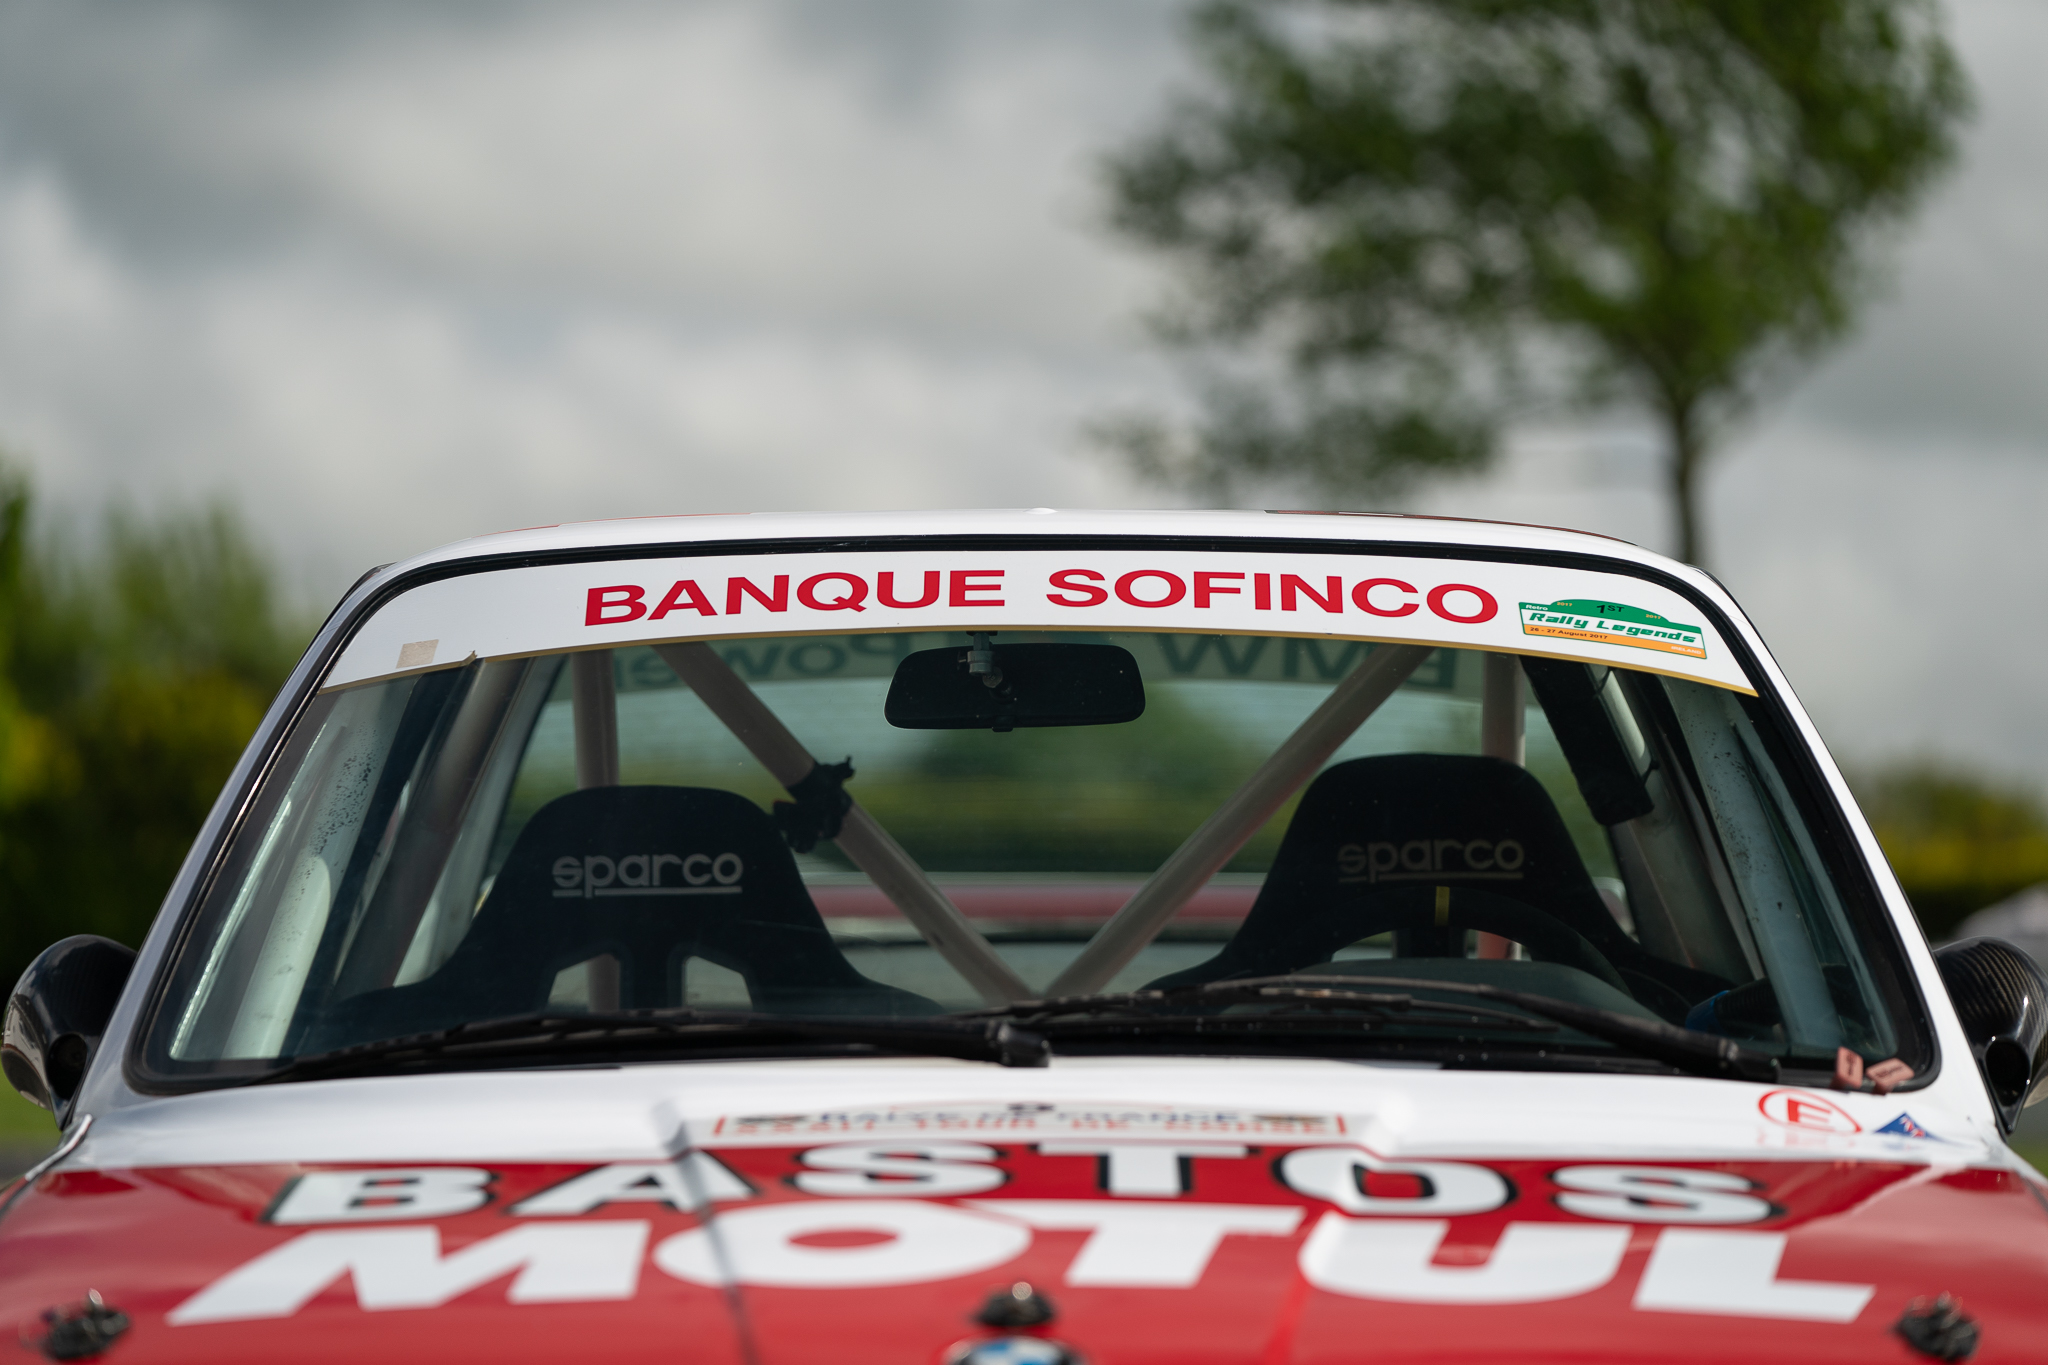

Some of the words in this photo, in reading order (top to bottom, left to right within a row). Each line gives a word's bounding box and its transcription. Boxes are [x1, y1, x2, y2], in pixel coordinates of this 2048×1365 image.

[584, 569, 1005, 626] BANQUE
[1046, 568, 1498, 624] SOFINCO
[1596, 604, 1625, 614] 1ST
[1529, 612, 1589, 629] Rally
[1596, 620, 1697, 643] Legends
[1670, 645, 1702, 655] IRELAND
[552, 852, 744, 899] sparco
[1337, 838, 1525, 884] sparco
[264, 1139, 1784, 1224] BASTOS
[165, 1200, 1876, 1325] MOTUL
